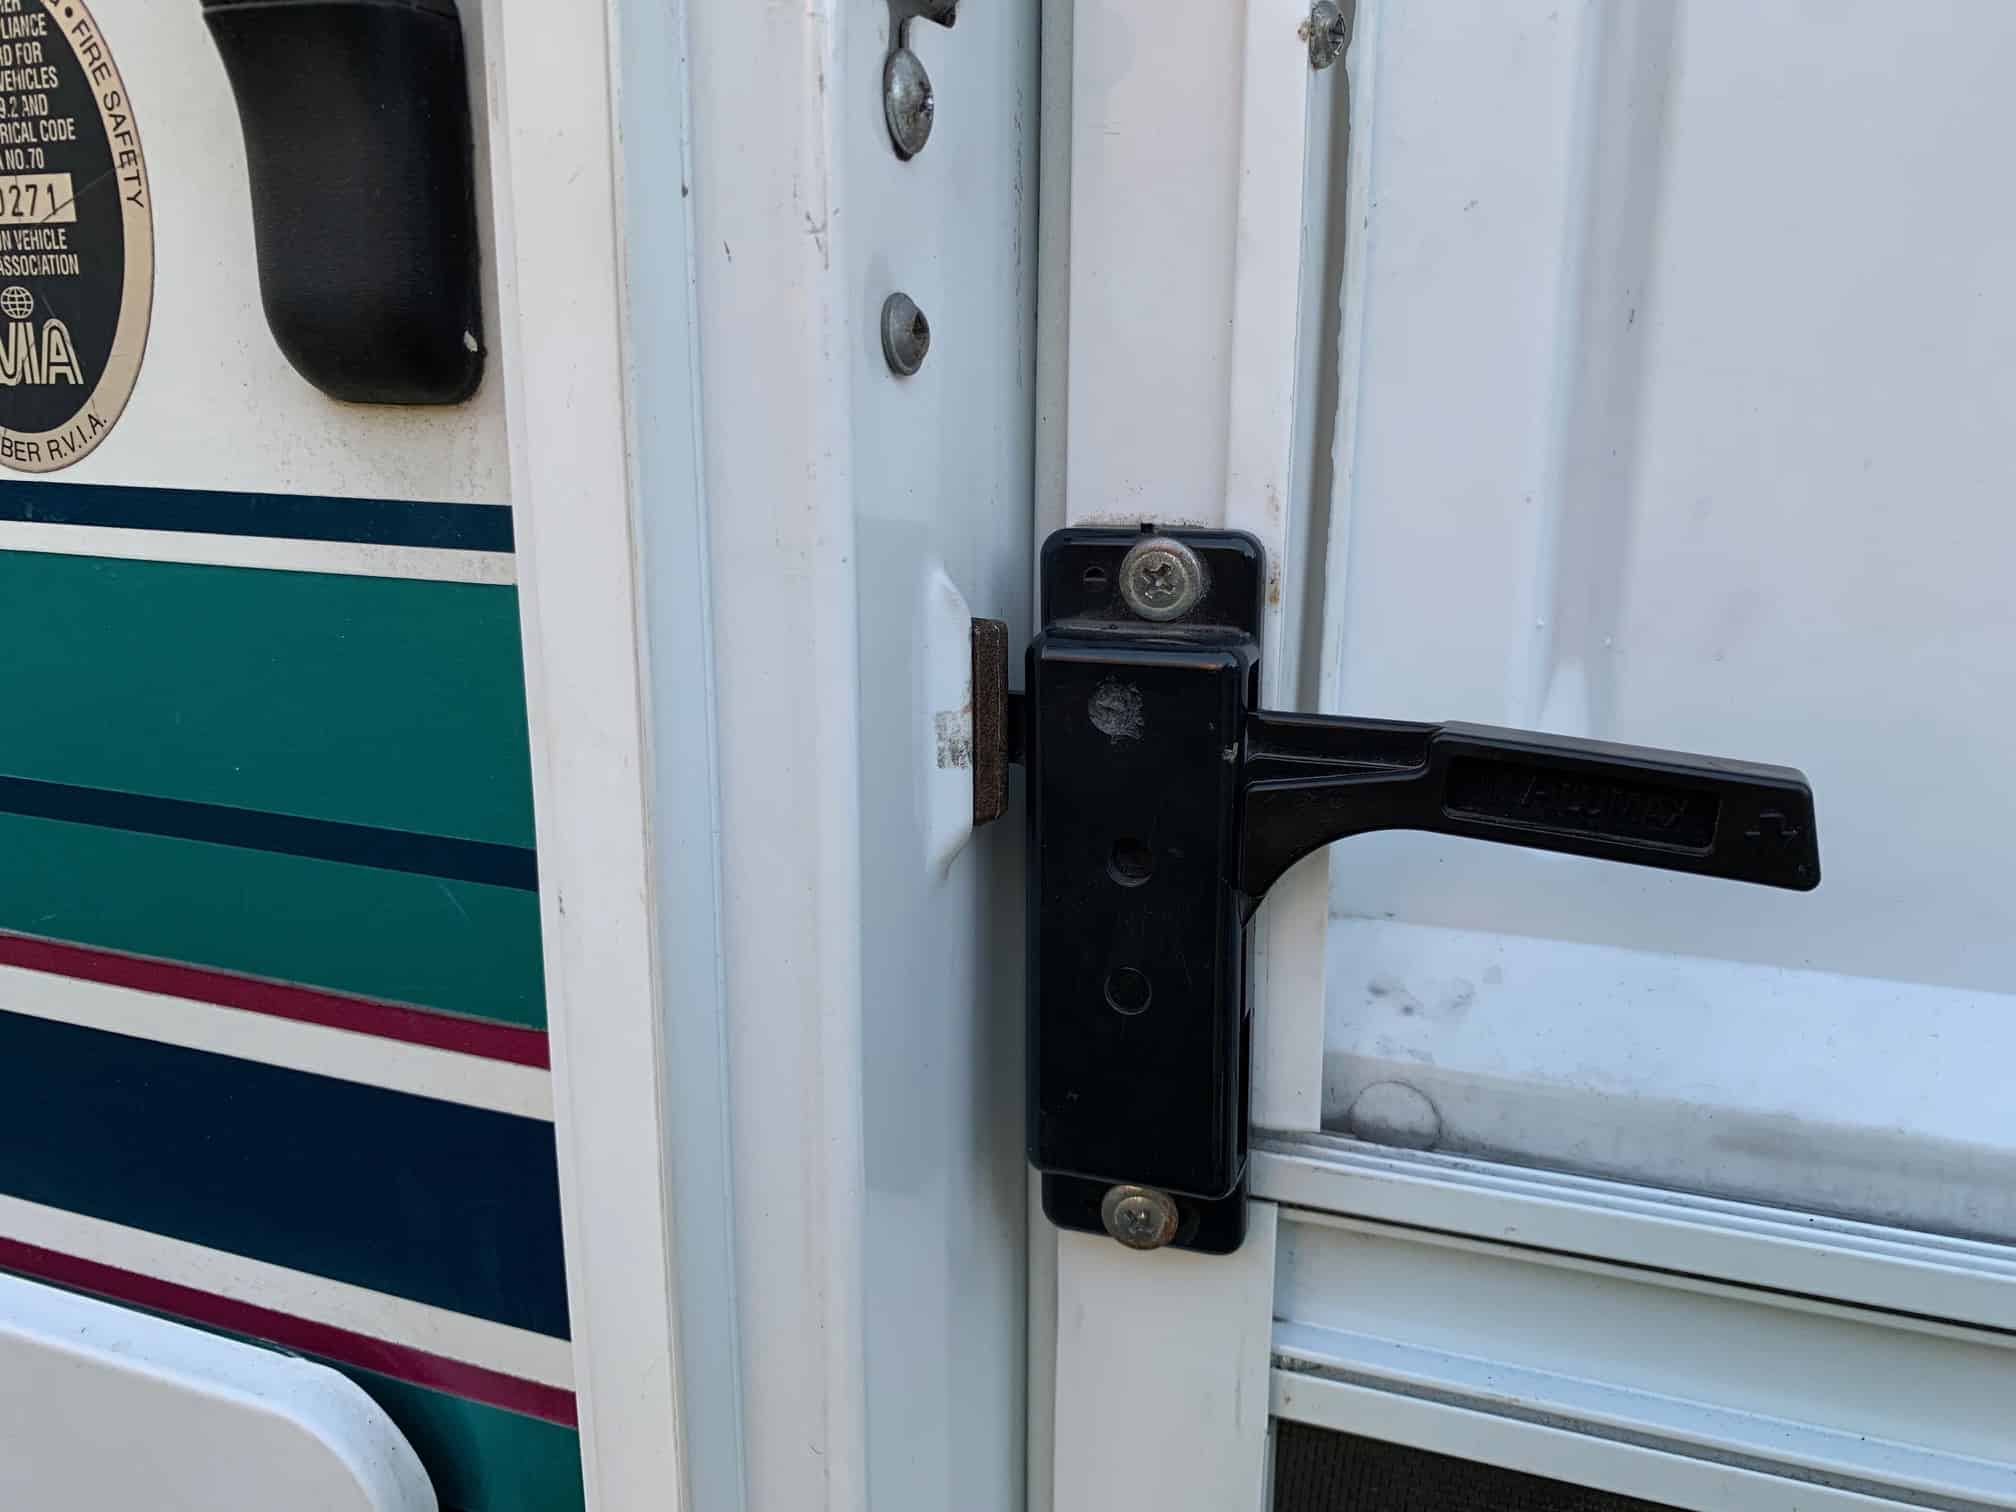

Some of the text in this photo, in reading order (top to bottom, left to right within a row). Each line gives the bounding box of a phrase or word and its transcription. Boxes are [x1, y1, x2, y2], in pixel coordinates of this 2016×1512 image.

[16, 42, 43, 65] FOR
[22, 94, 48, 117] AND
[72, 18, 144, 208] FIRE SAFETY
[39, 118, 76, 143] CODE
[13, 228, 68, 251] VEHICLE
[47, 413, 108, 460] R.V.I.A.
